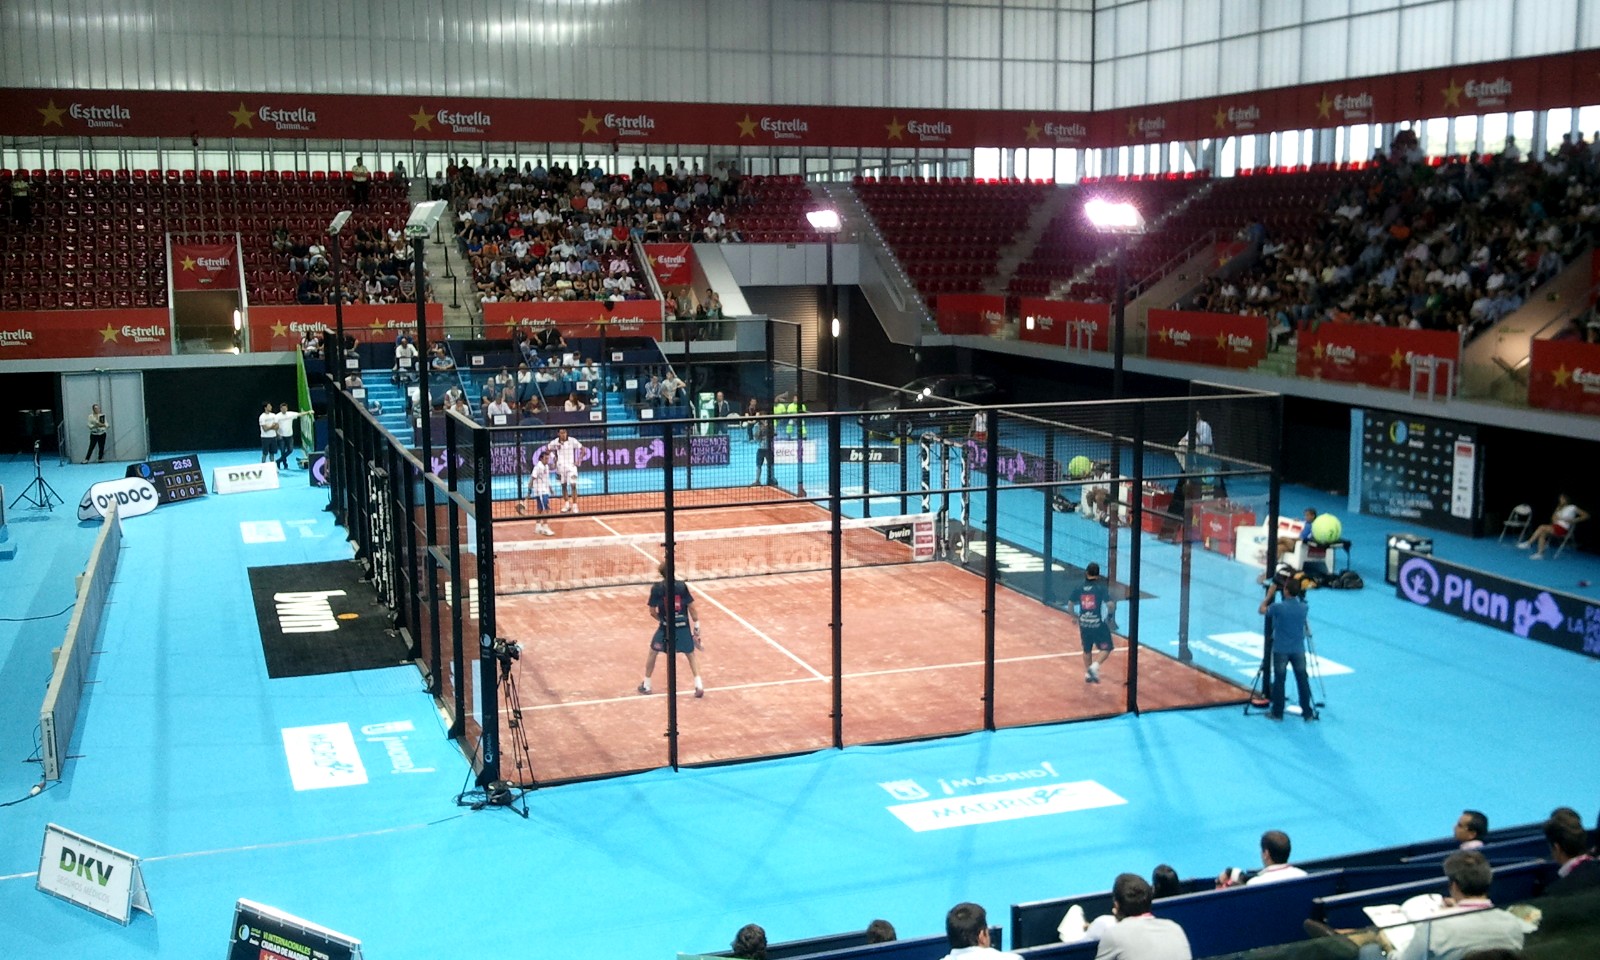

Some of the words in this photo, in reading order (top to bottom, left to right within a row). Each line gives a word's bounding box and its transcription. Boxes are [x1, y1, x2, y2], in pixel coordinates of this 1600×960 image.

[69, 103, 131, 119] Estrella
[258, 105, 317, 123] Estrella
[437, 109, 492, 126] Estrella
[604, 113, 655, 129] Estrella
[760, 116, 808, 132] Estrella
[907, 120, 952, 135] Estrella
[122, 325, 165, 336] Estrella
[387, 319, 418, 329] Estrell
[0, 329, 33, 339] strella
[172, 459, 192, 470] 23:53
[574, 446, 630, 467] Plan
[228, 470, 262, 483] DKV
[888, 528, 912, 540] bwin
[1443, 574, 1509, 623] Plan
[59, 846, 114, 887] DKV
